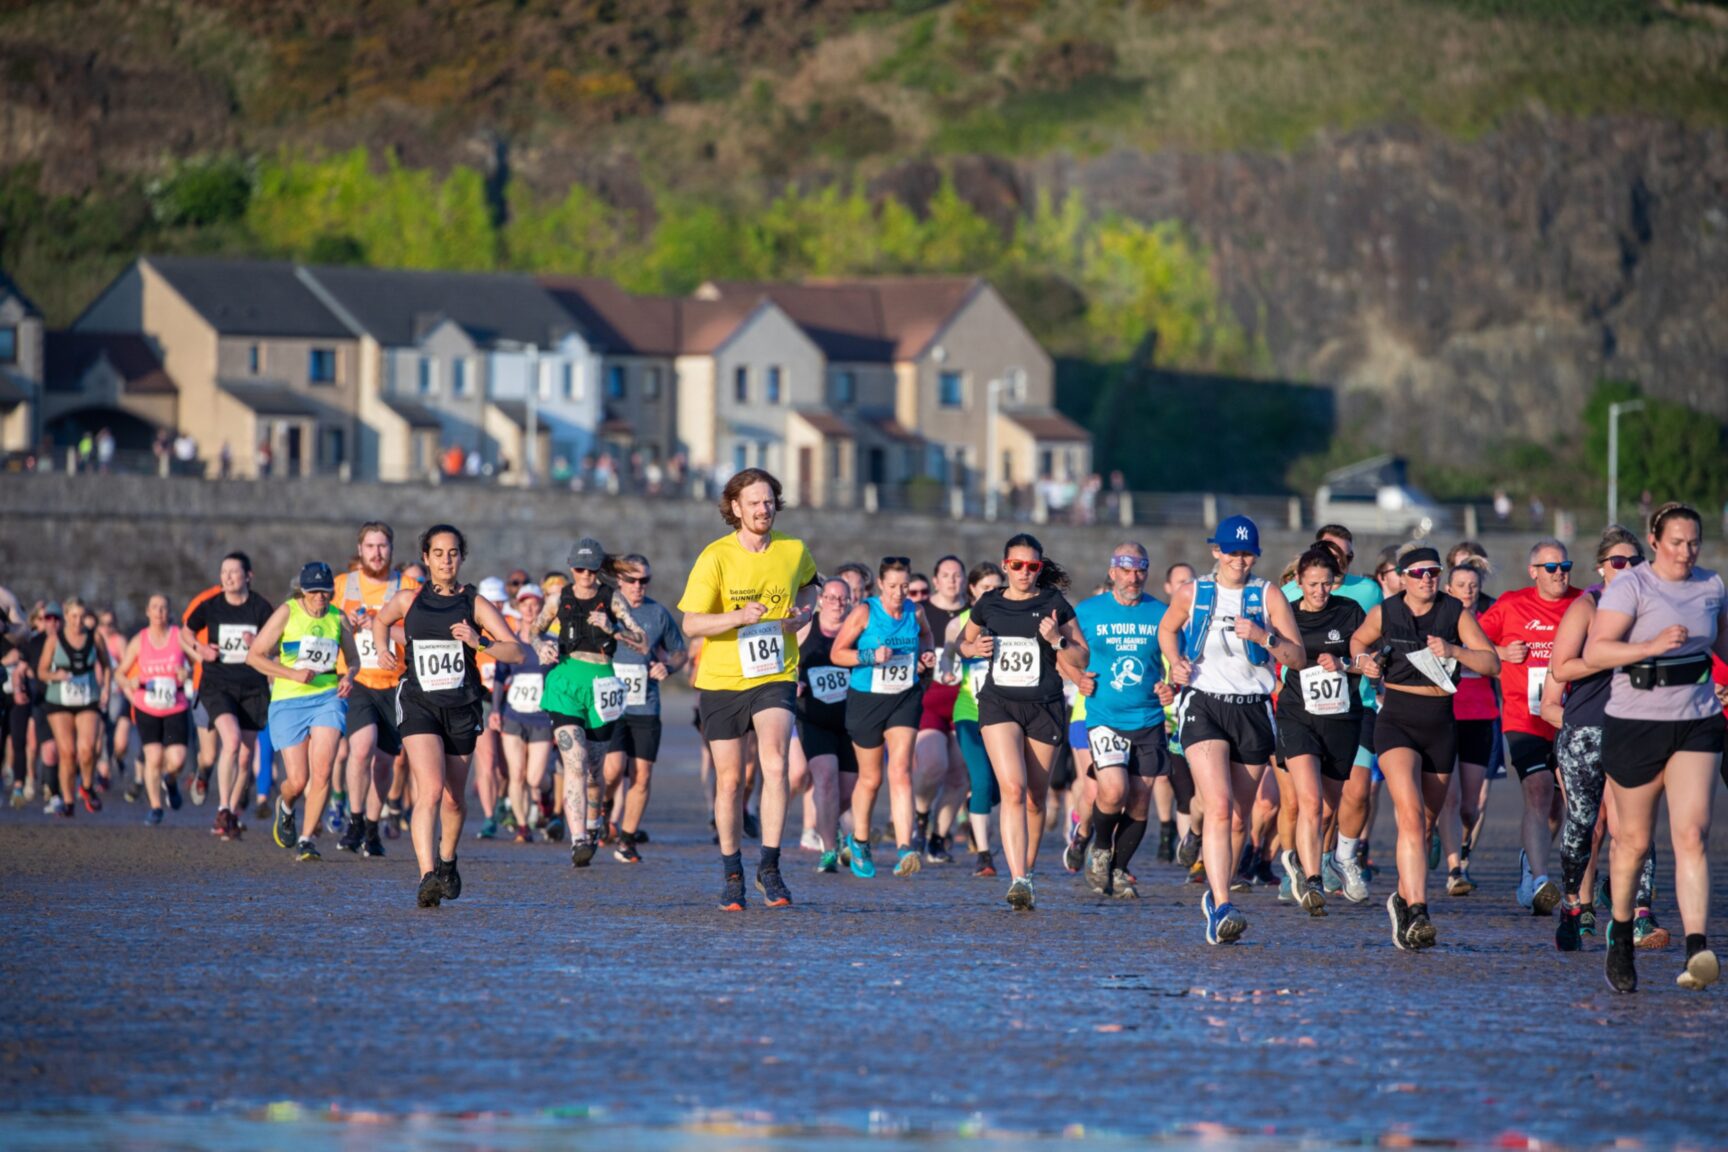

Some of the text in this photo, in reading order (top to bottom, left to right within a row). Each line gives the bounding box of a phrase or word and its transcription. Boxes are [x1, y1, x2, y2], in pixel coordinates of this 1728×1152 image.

[1096, 623, 1158, 636] 5K YOUR WAY
[748, 637, 780, 662] 184
[882, 636, 917, 646] othian
[1106, 637, 1148, 645] MOVE AGAINST
[1115, 644, 1138, 652] CANCER
[419, 652, 464, 676] 1046
[1000, 651, 1034, 672] 639
[816, 671, 847, 692] 988
[881, 665, 909, 681] 193
[513, 687, 538, 701] 792
[1309, 677, 1343, 700] 507
[600, 689, 624, 709] 503
[1093, 734, 1130, 756] 1265
